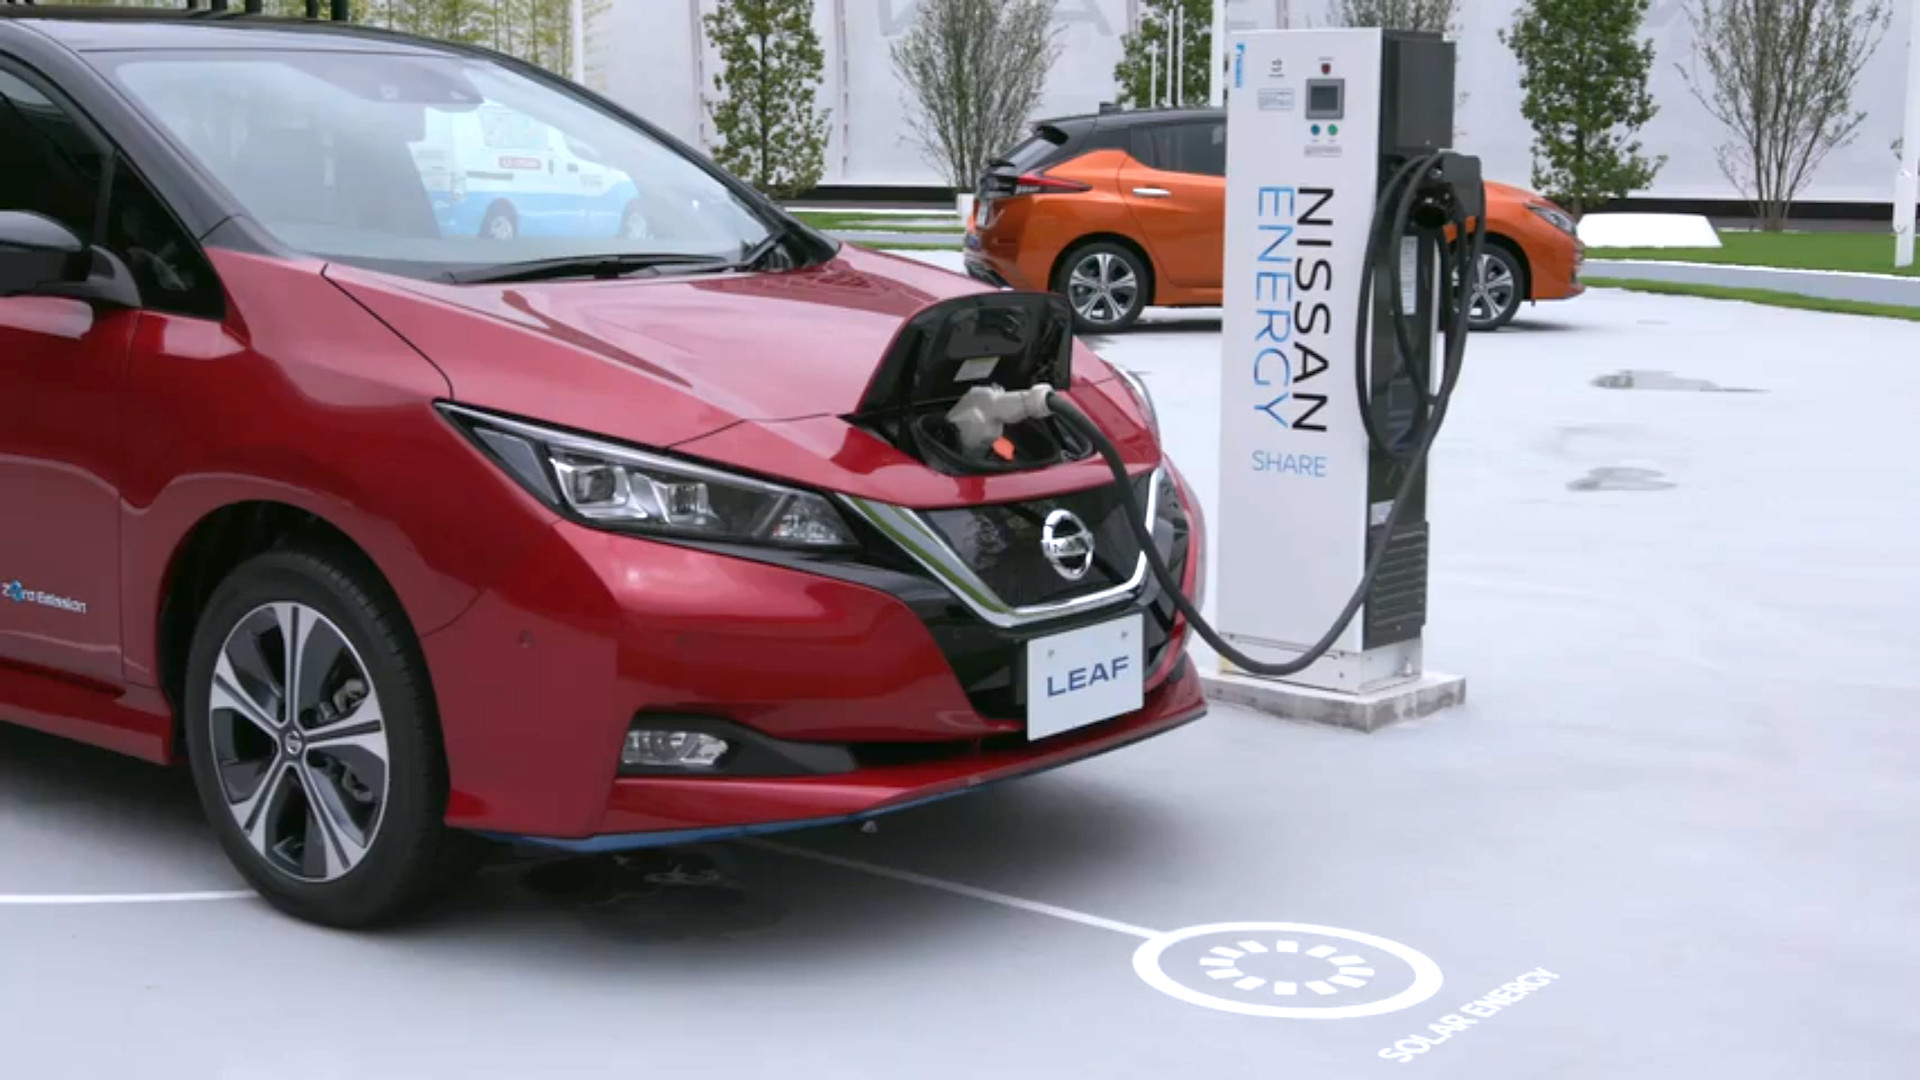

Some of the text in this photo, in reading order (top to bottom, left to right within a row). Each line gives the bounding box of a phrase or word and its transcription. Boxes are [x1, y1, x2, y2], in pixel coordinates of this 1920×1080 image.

[1254, 185, 1295, 429] ENERGY
[1292, 187, 1334, 432] NISSAN
[1251, 449, 1327, 478] SHARE
[1047, 655, 1129, 698] LEAF
[1377, 966, 1560, 1063] SOLAR ENERGY
